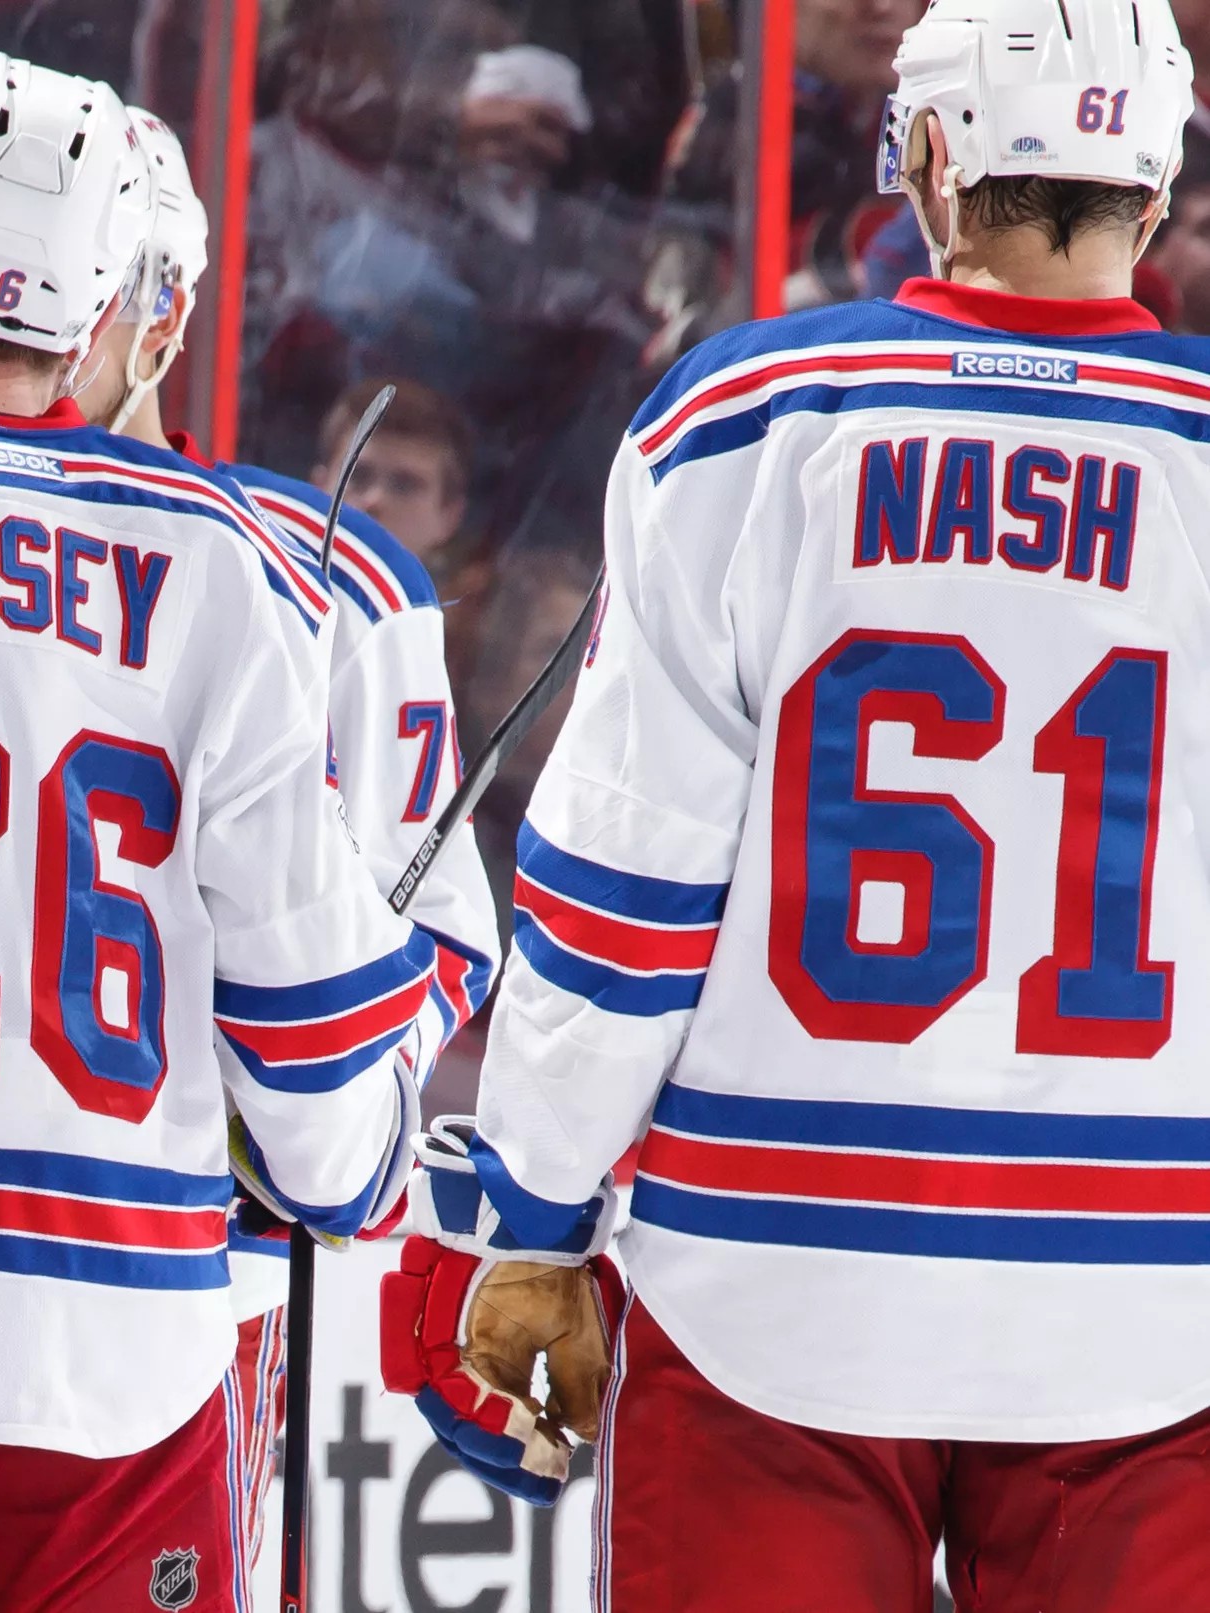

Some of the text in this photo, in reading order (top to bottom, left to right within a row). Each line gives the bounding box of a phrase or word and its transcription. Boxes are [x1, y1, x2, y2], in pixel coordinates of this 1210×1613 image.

[1076, 86, 1130, 136] 61
[957, 353, 1072, 381] Reebok
[853, 438, 1142, 592] NASH
[398, 700, 474, 824] 7
[392, 828, 442, 911] BAUER
[768, 627, 1176, 1060] 61
[160, 1563, 190, 1598] NHL
